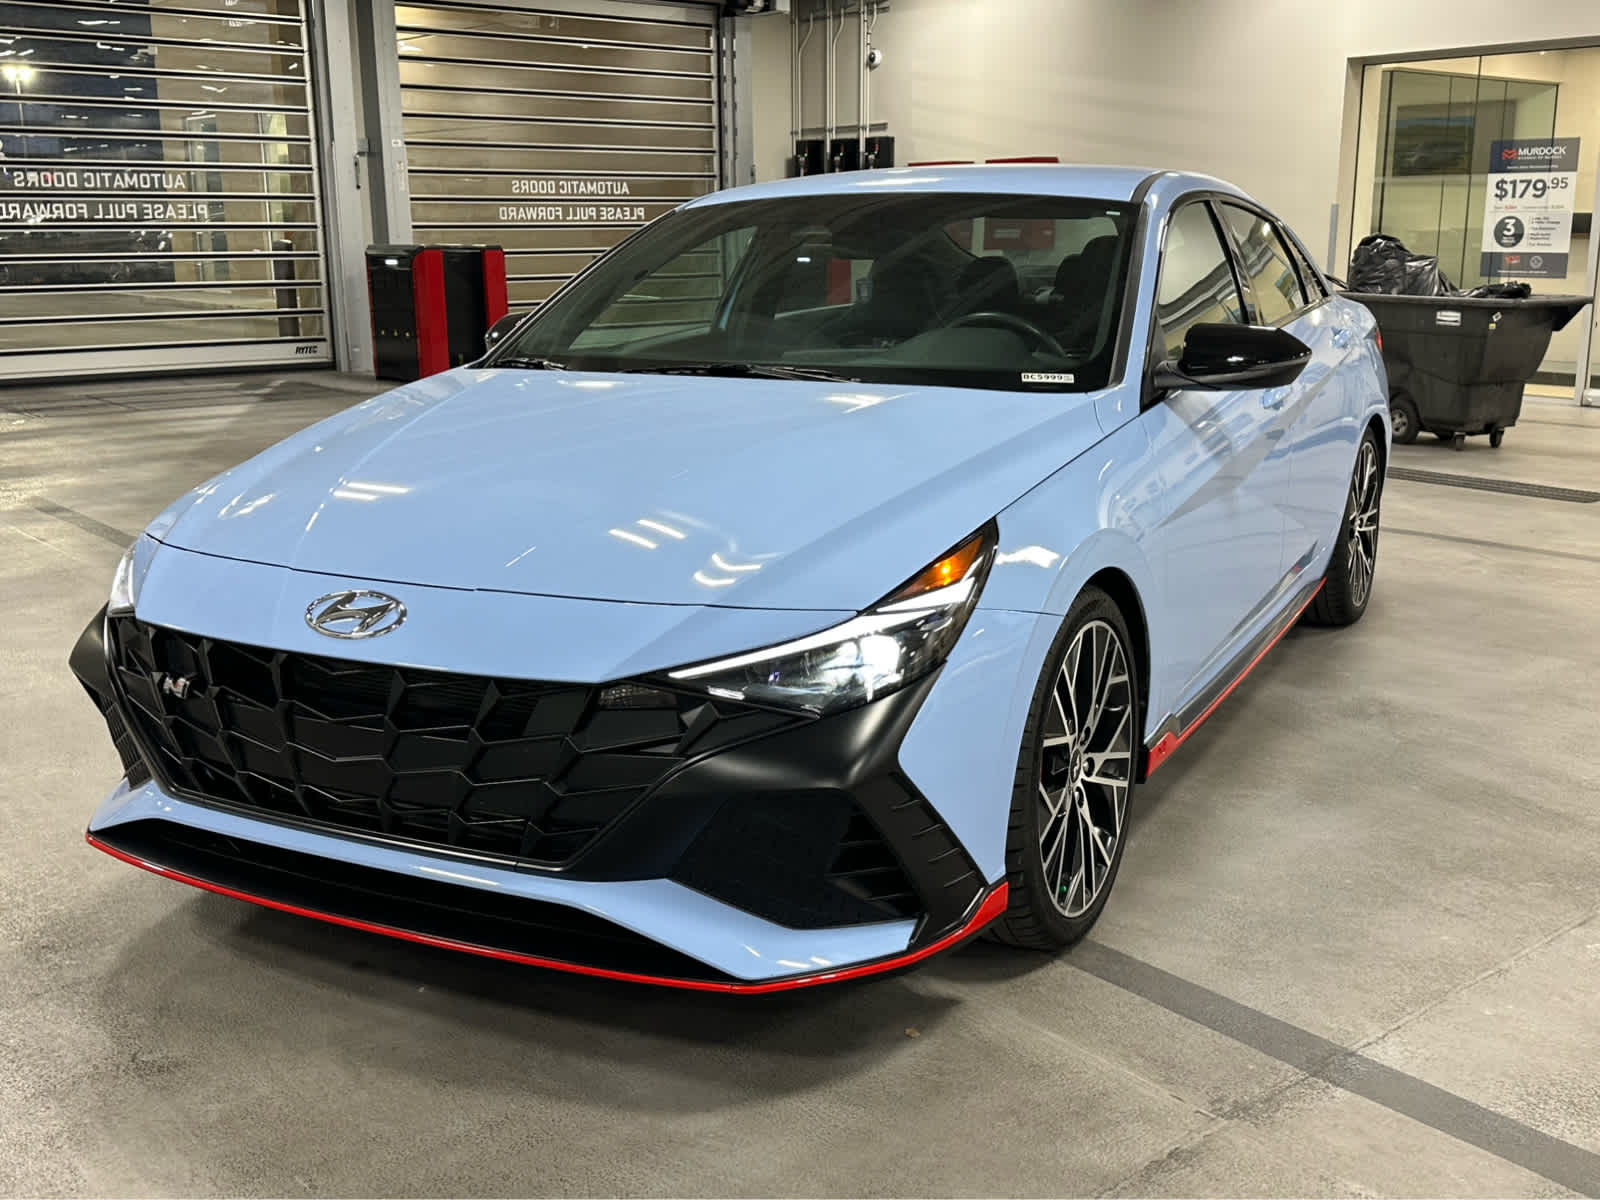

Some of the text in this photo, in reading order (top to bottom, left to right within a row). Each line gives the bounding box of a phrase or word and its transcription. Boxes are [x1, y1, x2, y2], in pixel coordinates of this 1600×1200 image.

[1518, 146, 1567, 155] MURDOCK
[1494, 177, 1569, 201] $179.95
[1502, 218, 1516, 236] 3
